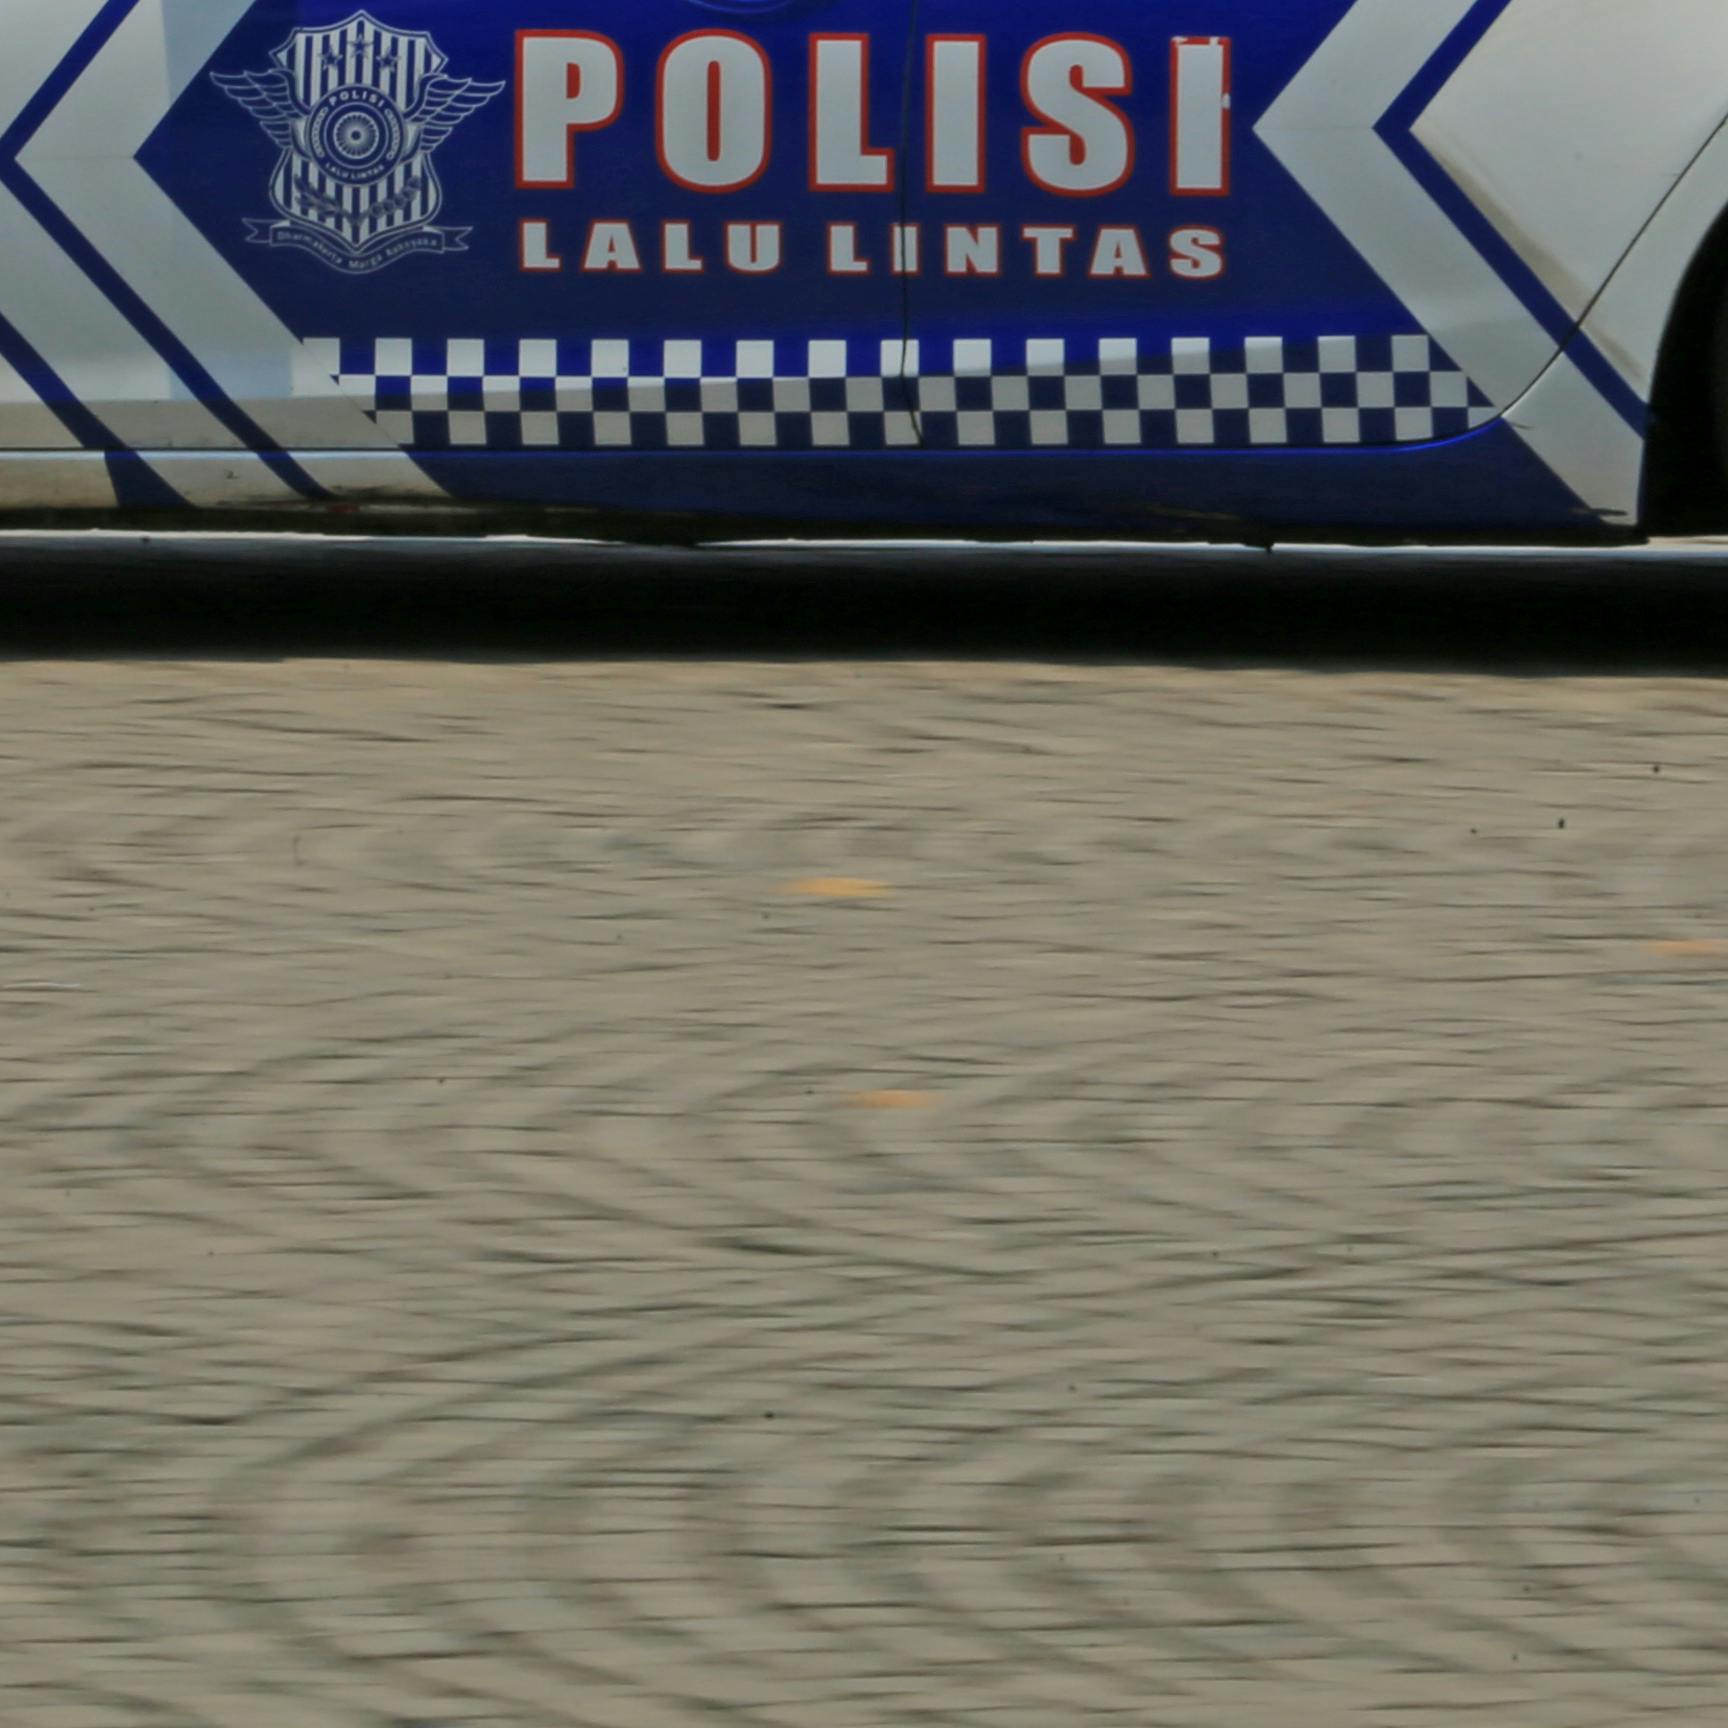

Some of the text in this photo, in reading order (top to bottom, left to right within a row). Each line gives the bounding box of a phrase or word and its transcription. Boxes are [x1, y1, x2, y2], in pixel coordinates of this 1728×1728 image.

[514, 28, 1231, 195] POLISI
[520, 219, 1226, 278] LALU LINTAS
